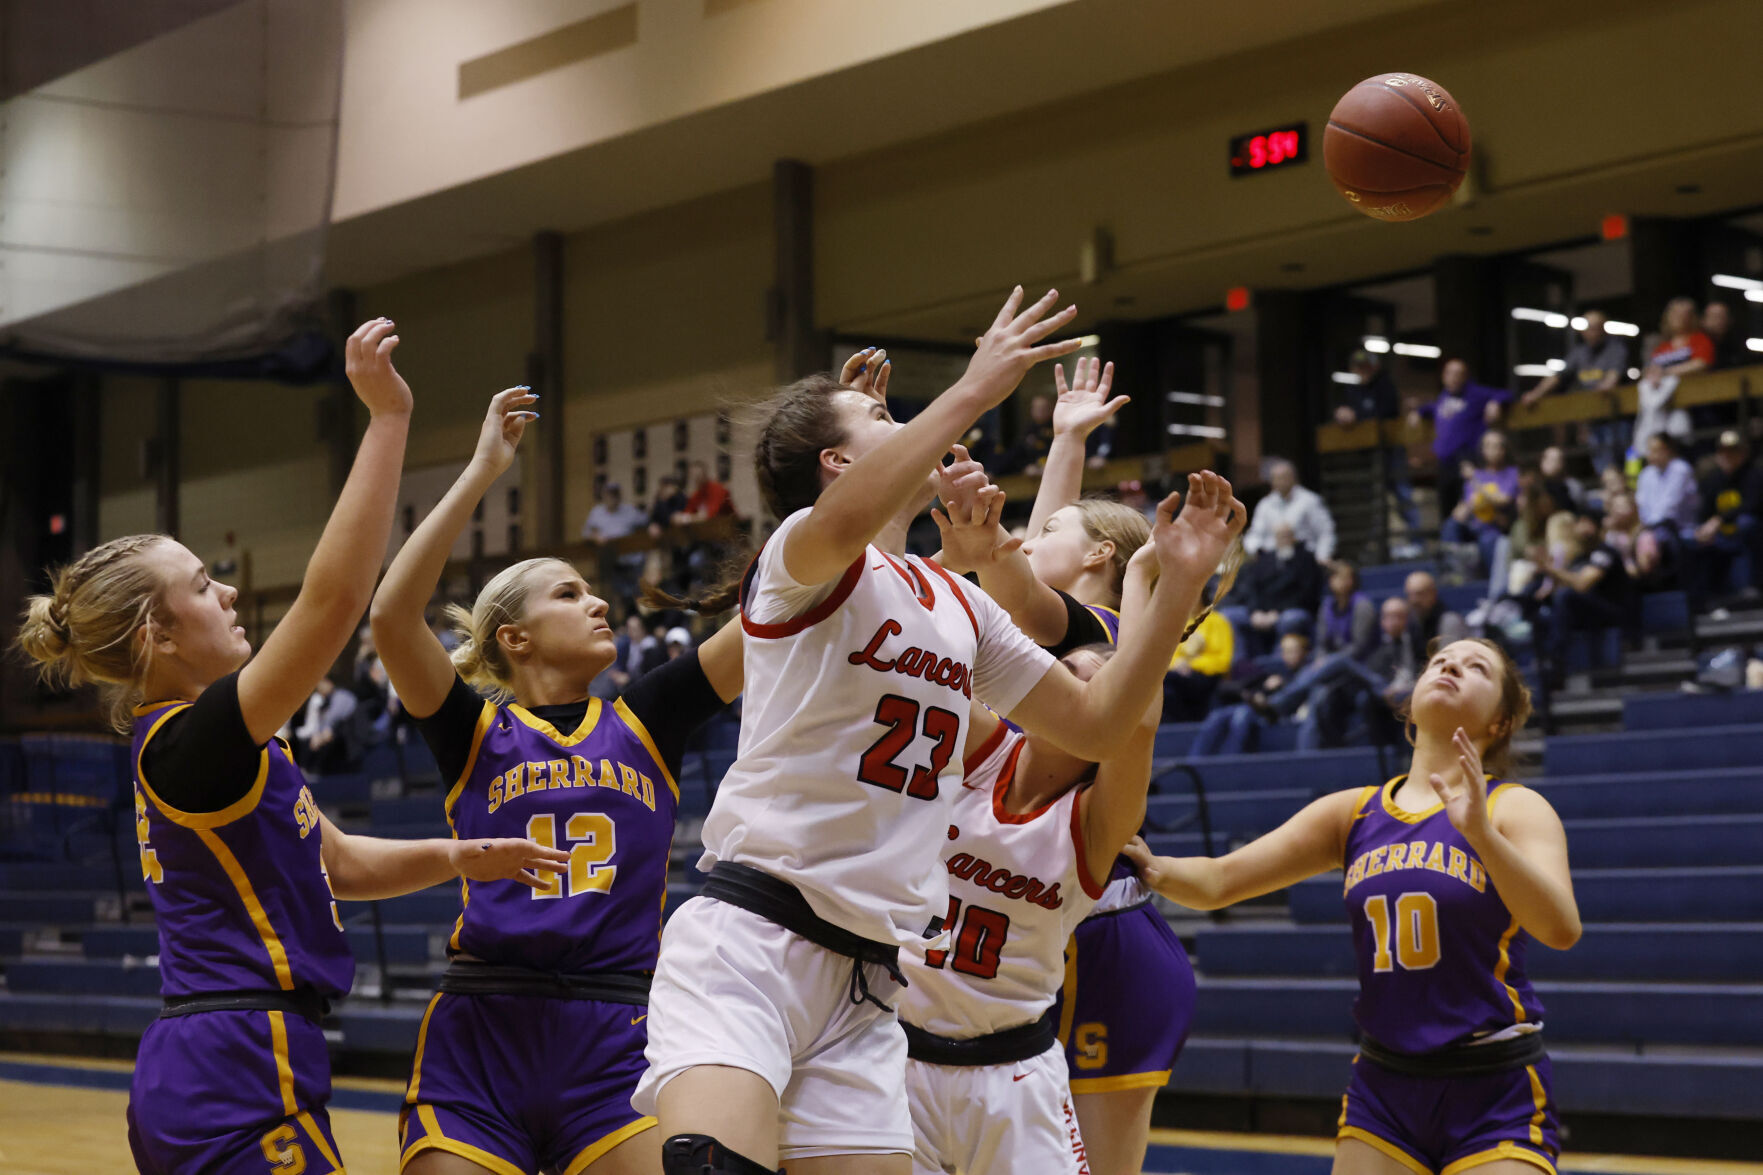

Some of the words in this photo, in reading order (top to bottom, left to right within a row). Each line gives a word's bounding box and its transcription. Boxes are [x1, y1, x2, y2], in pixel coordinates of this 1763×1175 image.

[488, 755, 656, 815] SHERRARD
[857, 693, 960, 801] 23
[525, 812, 617, 900] 12
[945, 824, 1064, 911] ancers
[1363, 891, 1442, 973] 10
